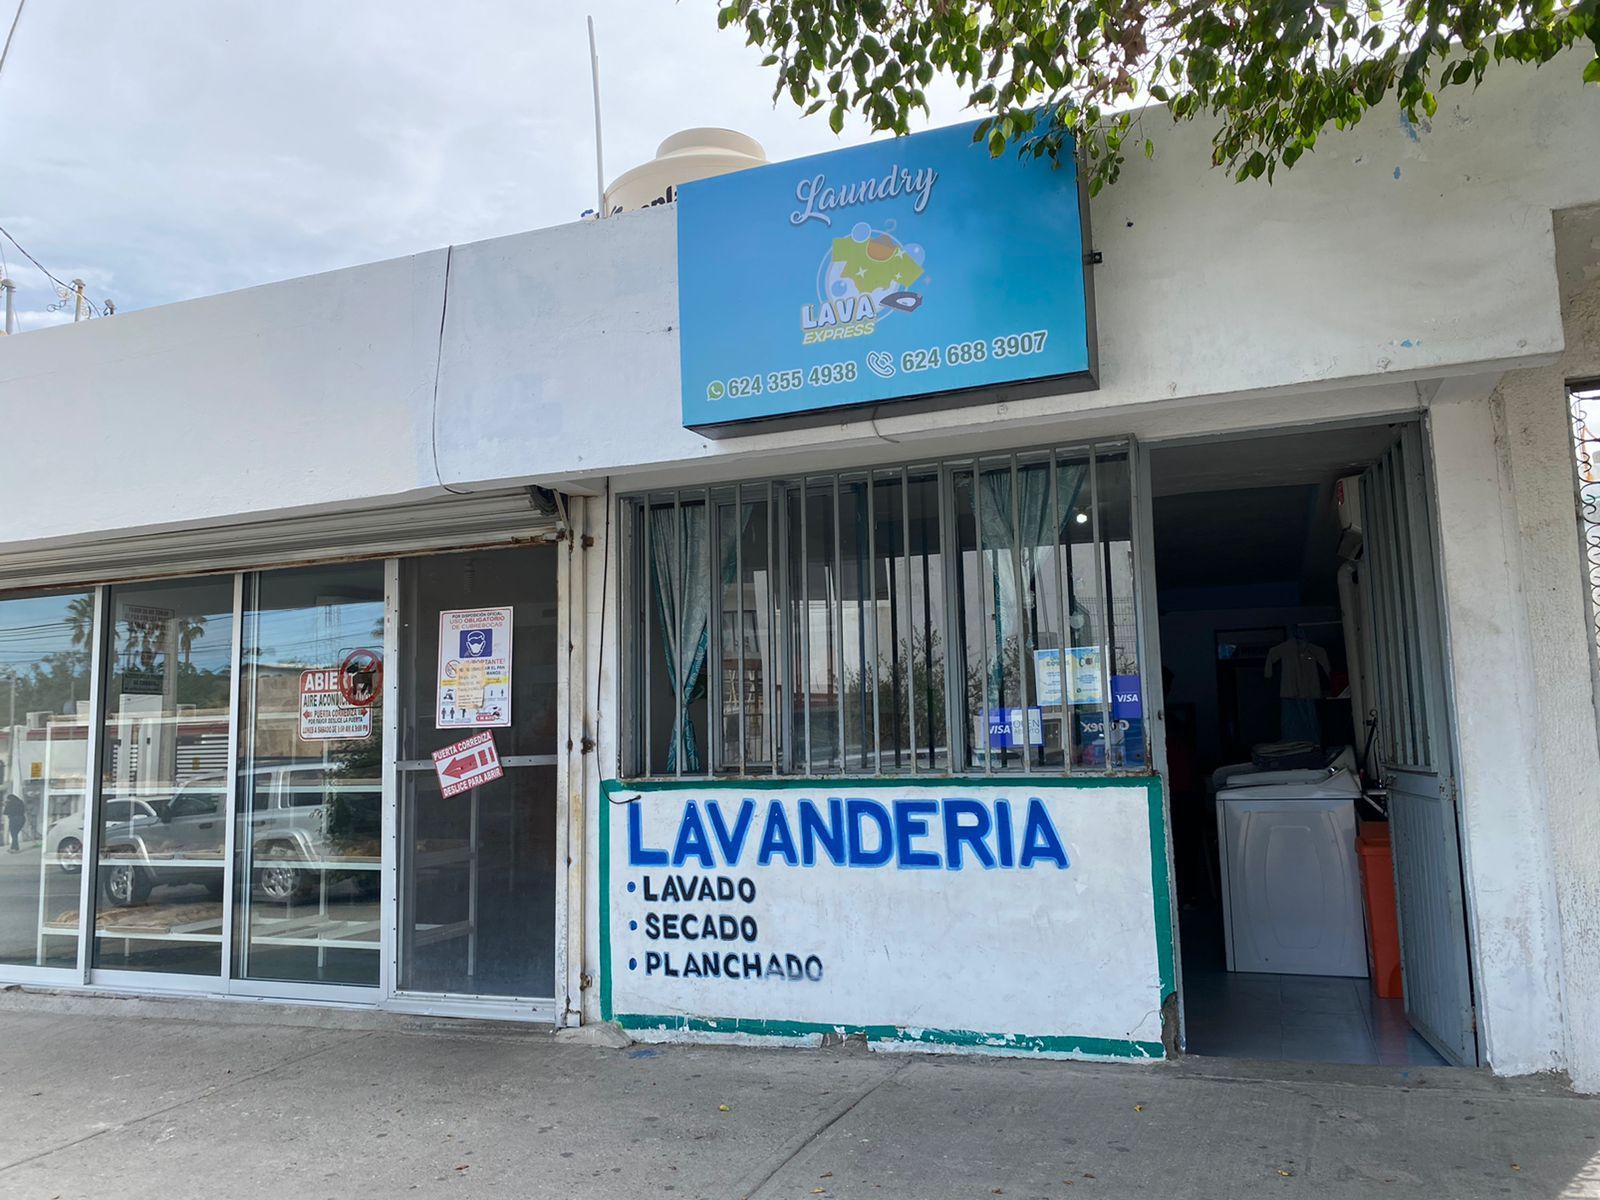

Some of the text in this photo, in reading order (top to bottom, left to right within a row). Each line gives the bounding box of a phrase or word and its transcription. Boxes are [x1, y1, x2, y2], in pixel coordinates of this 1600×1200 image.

[790, 164, 937, 226] Laundry
[801, 295, 875, 329] LAVA
[802, 322, 875, 345] EXPRESS
[901, 330, 1048, 373] 624 688 3907
[728, 363, 857, 398] 624 355 4938
[461, 622, 503, 630] CUBREBOCAS
[464, 615, 505, 624] OBLIGATORIO
[303, 694, 317, 707] AIRE
[1115, 694, 1139, 703] VISA
[313, 709, 331, 718] PUERTA
[1013, 719, 1040, 729] OEN
[989, 724, 1011, 734] VISA
[433, 731, 492, 761] PUERTA CORREDIZA
[443, 767, 501, 797] DESLICE PARA ABRIR
[626, 796, 1071, 871] LAVANDERIA
[642, 874, 756, 903] LAVADO
[645, 912, 758, 942] SECADO
[645, 951, 824, 982] PLANCHADO
